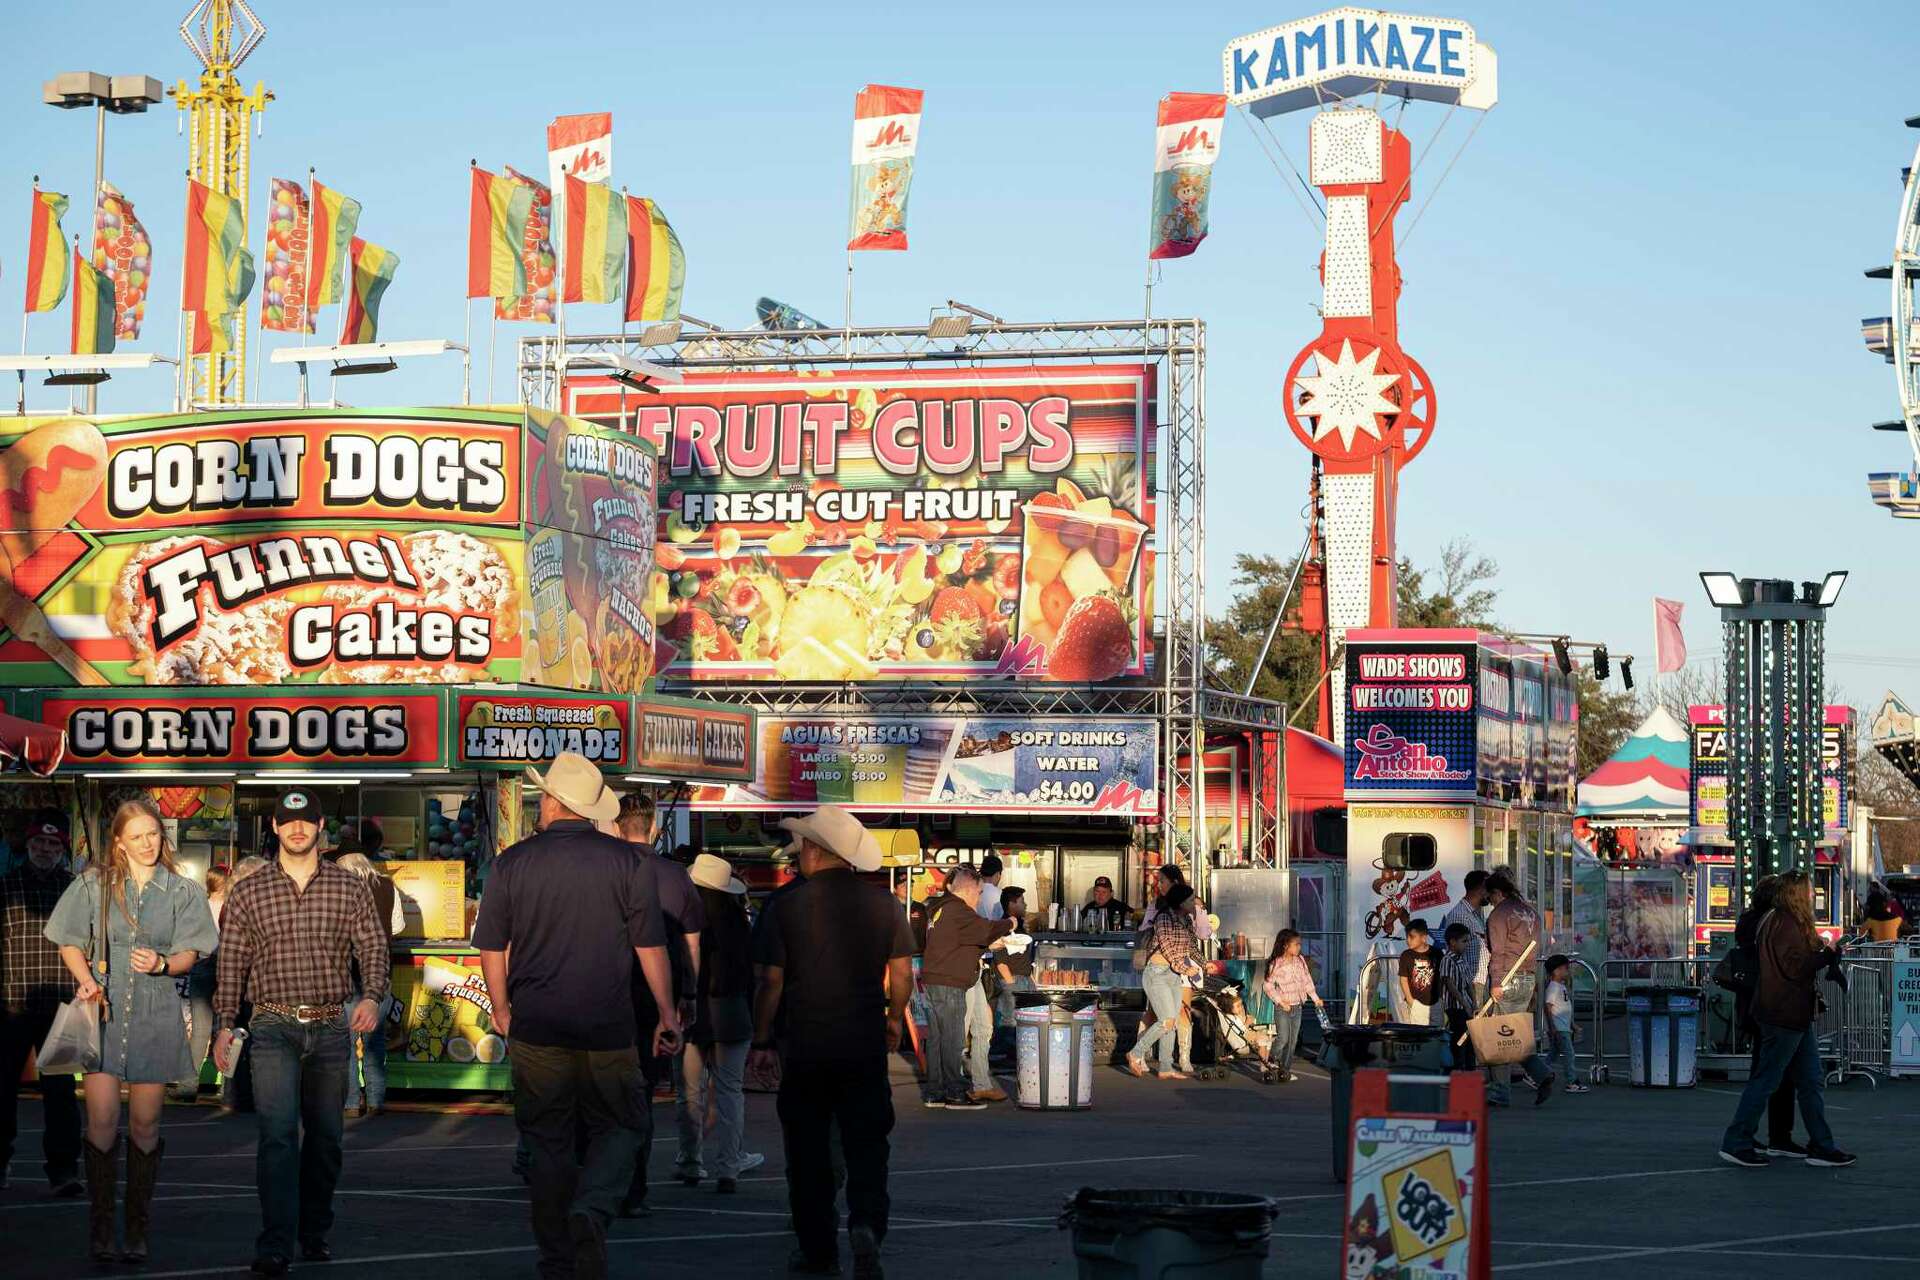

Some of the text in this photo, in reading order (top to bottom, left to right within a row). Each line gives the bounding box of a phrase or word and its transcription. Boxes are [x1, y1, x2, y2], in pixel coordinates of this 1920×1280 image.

[1233, 18, 1465, 95] KAMIKAZE
[637, 398, 1074, 477] FRUIT CUPS
[110, 435, 507, 514] CORN DOGS
[565, 434, 653, 489] CORN DOGS
[593, 497, 638, 530] Funnel
[684, 490, 1017, 522] FRESH CUT FRUIT
[611, 529, 642, 551] Cakes
[150, 535, 420, 646] Funnel
[611, 586, 652, 645] NACHOS
[292, 604, 490, 661] Cakes
[1362, 657, 1462, 677] WADE SHOWS
[1355, 688, 1469, 708] WELCOMES YOU
[74, 707, 406, 752] CORN DOGS
[494, 705, 596, 725] Fresh Squeezed
[466, 727, 621, 760] LEMONADE
[643, 713, 746, 761] FUNNEL CAKES
[781, 726, 922, 744] AGUAS FRESCAS
[1011, 731, 1126, 746] SOFT DRINKS
[800, 753, 886, 765] LARGE $5.00
[1037, 757, 1100, 771] WATER
[1355, 753, 1448, 779] Antonio
[1379, 770, 1406, 780] Stock
[1407, 770, 1429, 780] Show
[800, 770, 887, 783] JUMBO $8.00
[1039, 780, 1095, 802] $4.00
[1401, 1172, 1455, 1217] LOOK
[1397, 1200, 1448, 1246] OUT!
